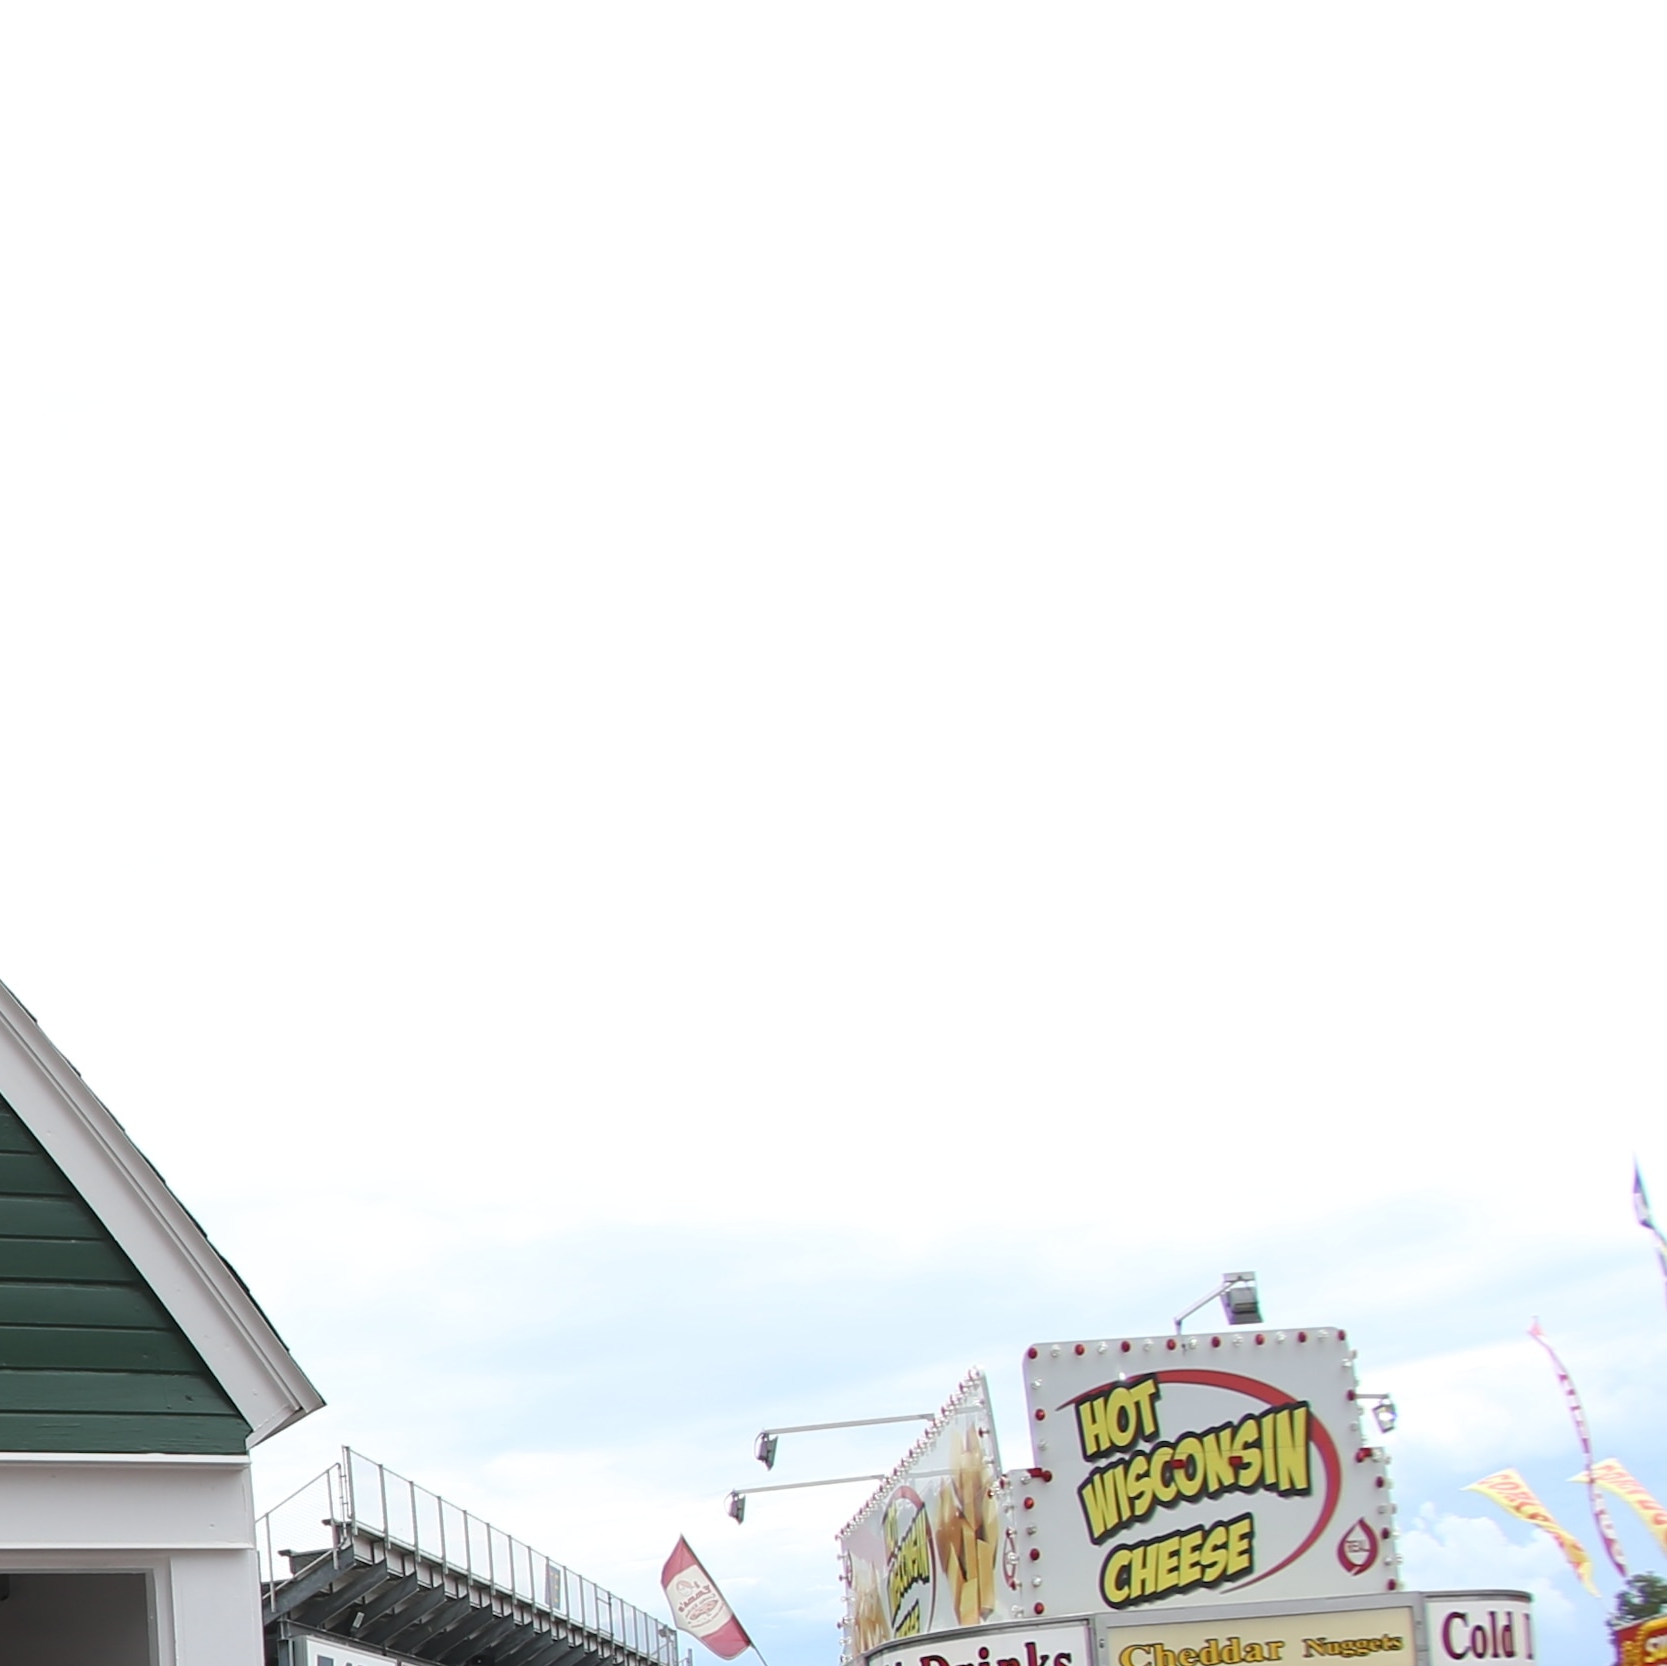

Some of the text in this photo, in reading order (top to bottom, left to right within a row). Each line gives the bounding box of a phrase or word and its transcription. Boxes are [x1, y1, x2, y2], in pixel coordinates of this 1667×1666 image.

[1078, 1376, 1158, 1459] HOT
[1081, 1404, 1310, 1541] WISCONSIN
[1102, 1516, 1253, 1605] CHEESE
[1302, 1633, 1405, 1659] Nuggets
[1442, 1610, 1516, 1661] Cold
